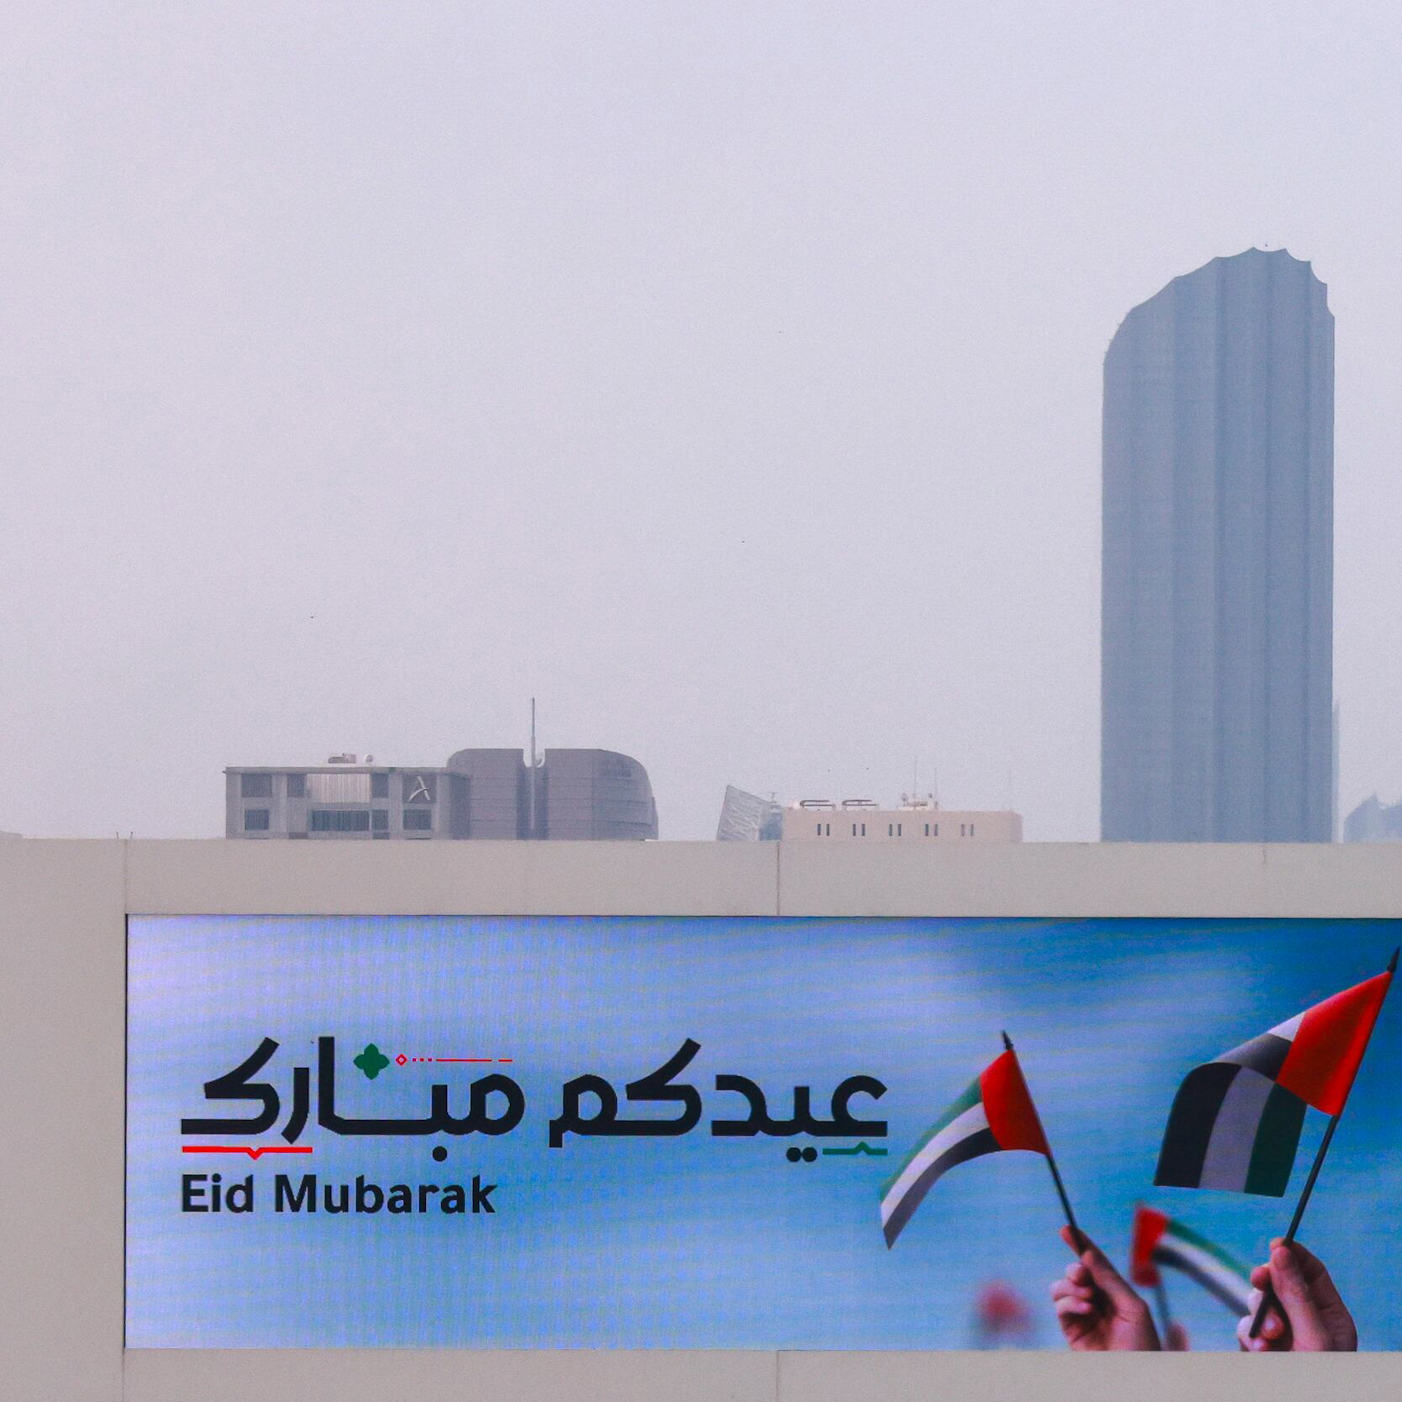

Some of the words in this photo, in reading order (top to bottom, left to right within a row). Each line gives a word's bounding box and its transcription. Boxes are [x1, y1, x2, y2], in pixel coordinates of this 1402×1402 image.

[181, 1036, 525, 1163] مبارك
[548, 1037, 888, 1163] عيدكم
[181, 1173, 255, 1215] Eid
[274, 1174, 499, 1215] Mubarak
